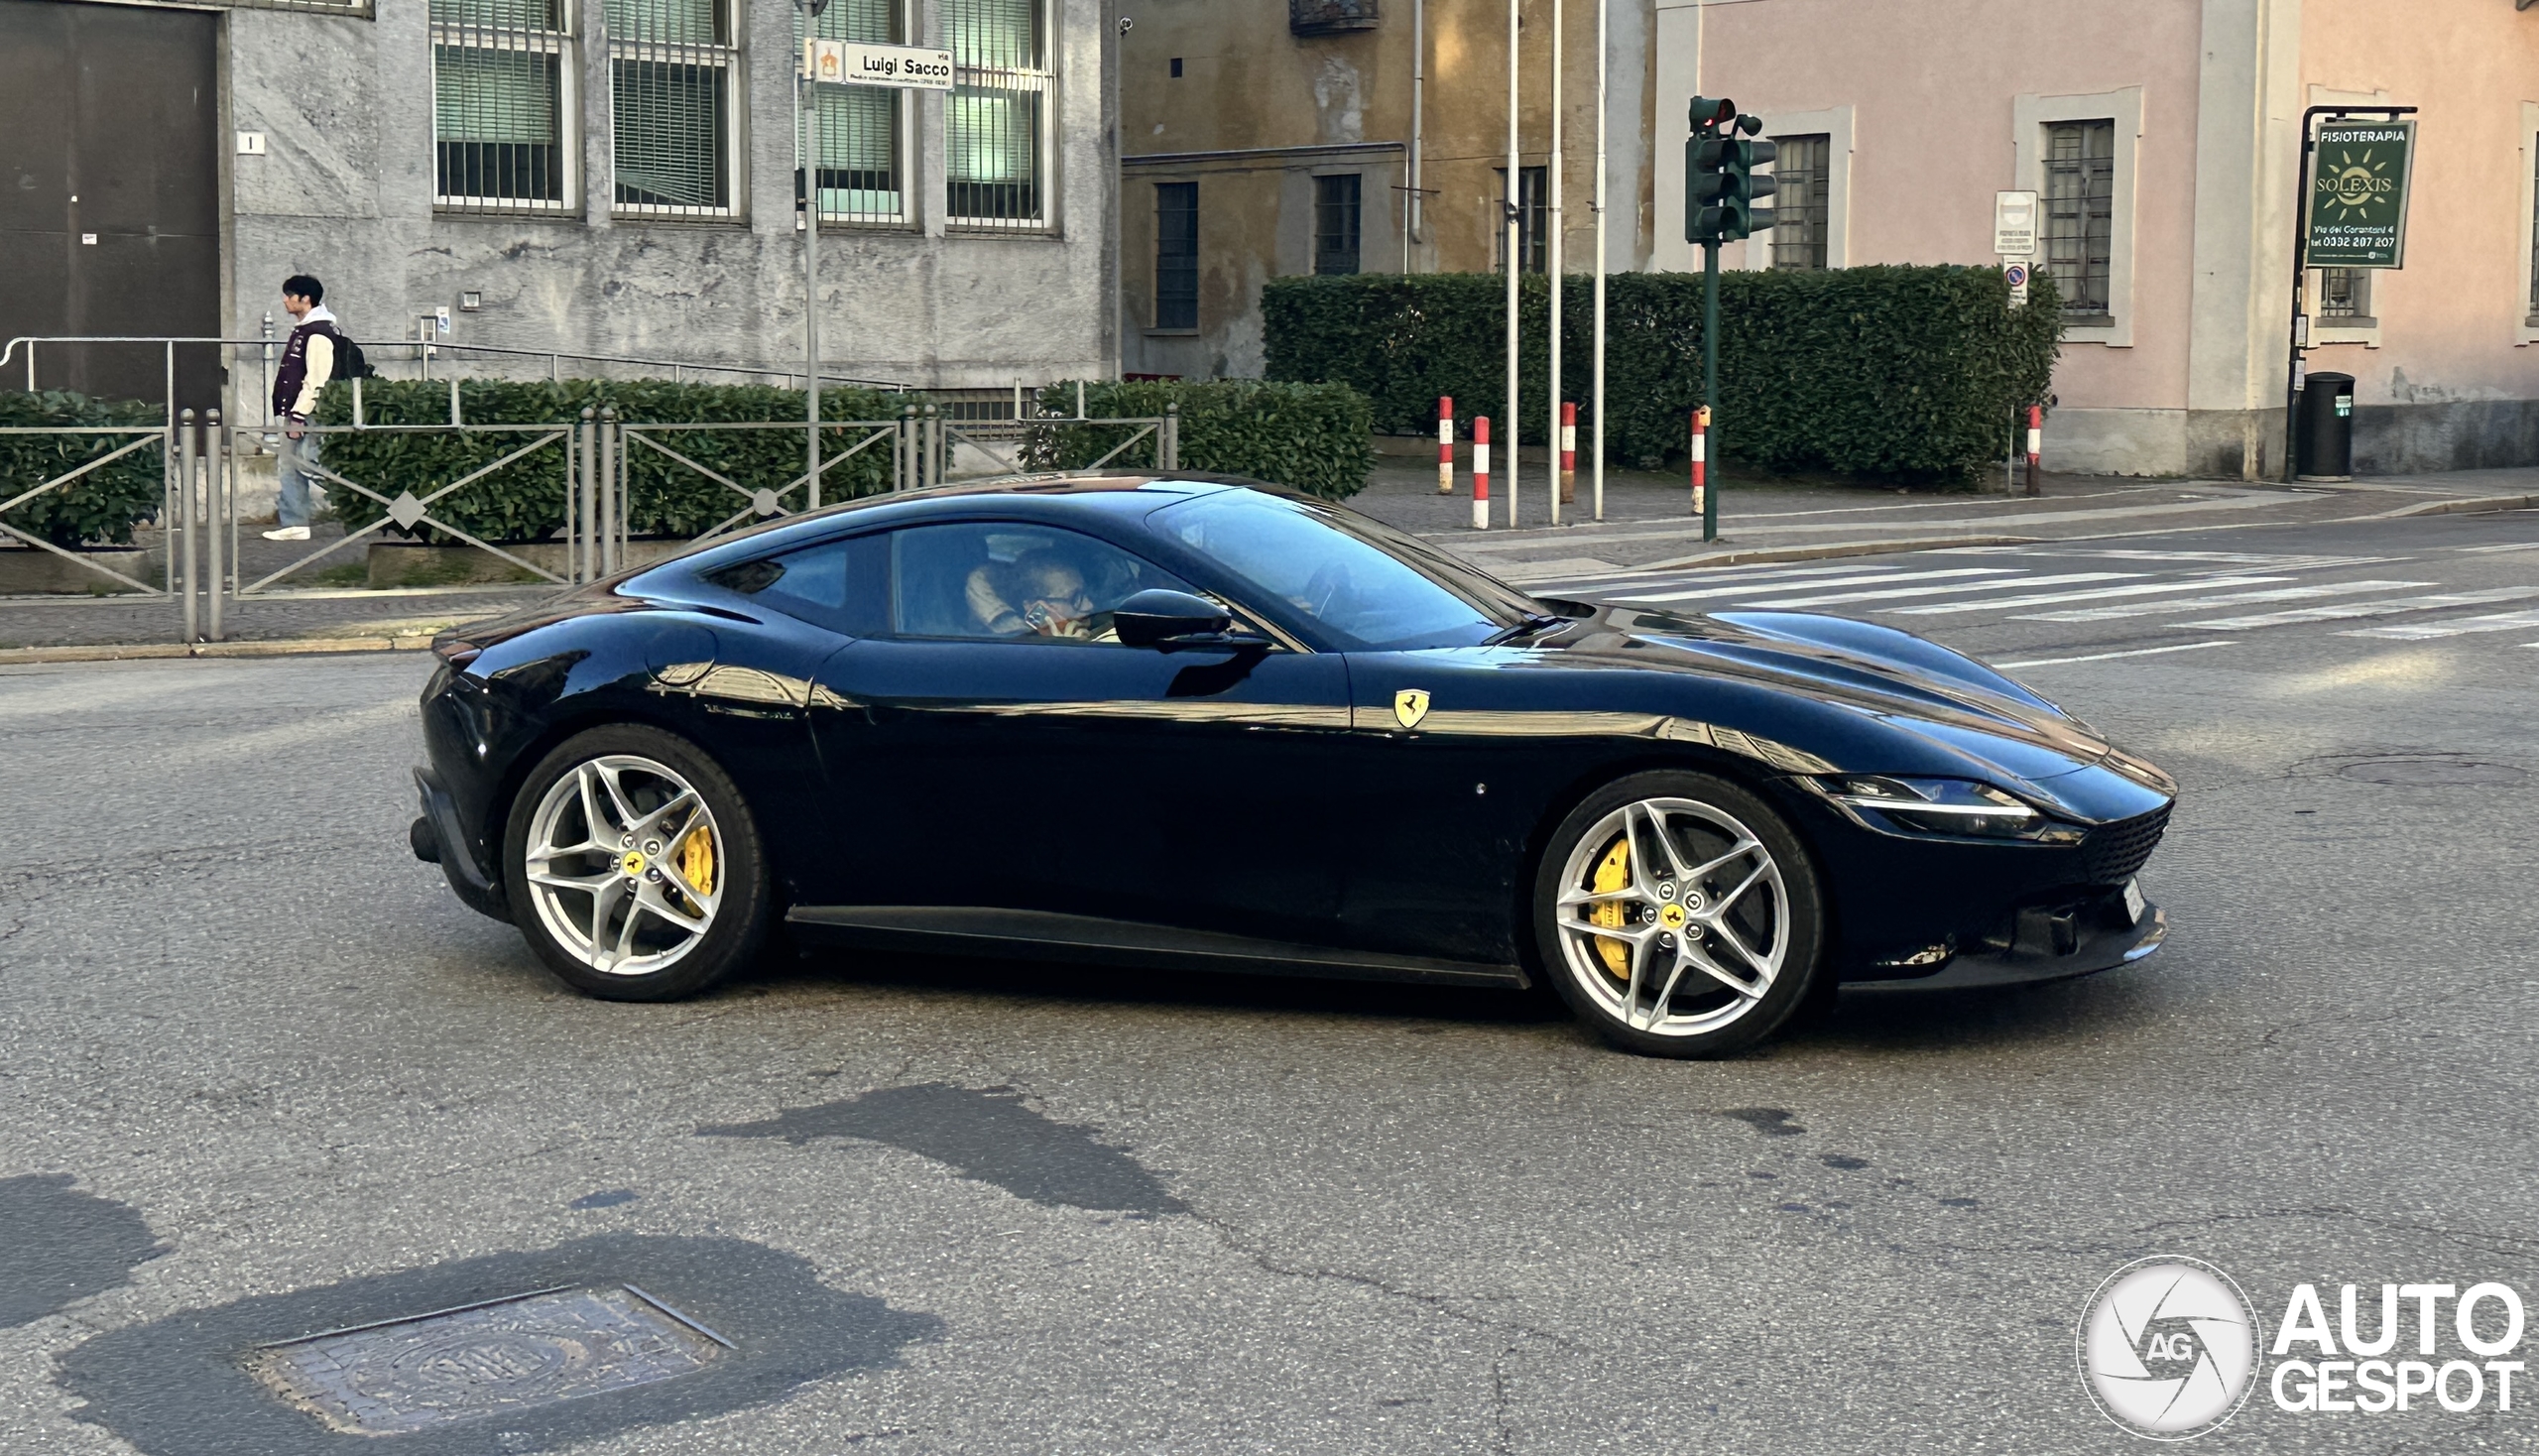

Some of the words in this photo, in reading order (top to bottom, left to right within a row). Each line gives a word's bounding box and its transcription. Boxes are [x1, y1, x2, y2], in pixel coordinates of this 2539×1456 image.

[863, 56, 898, 74] Luigi
[905, 59, 949, 76] Sacco
[2321, 131, 2405, 142] FISIOTERAPIA
[2317, 179, 2391, 191] SOLEXIS
[2314, 225, 2327, 234] Via
